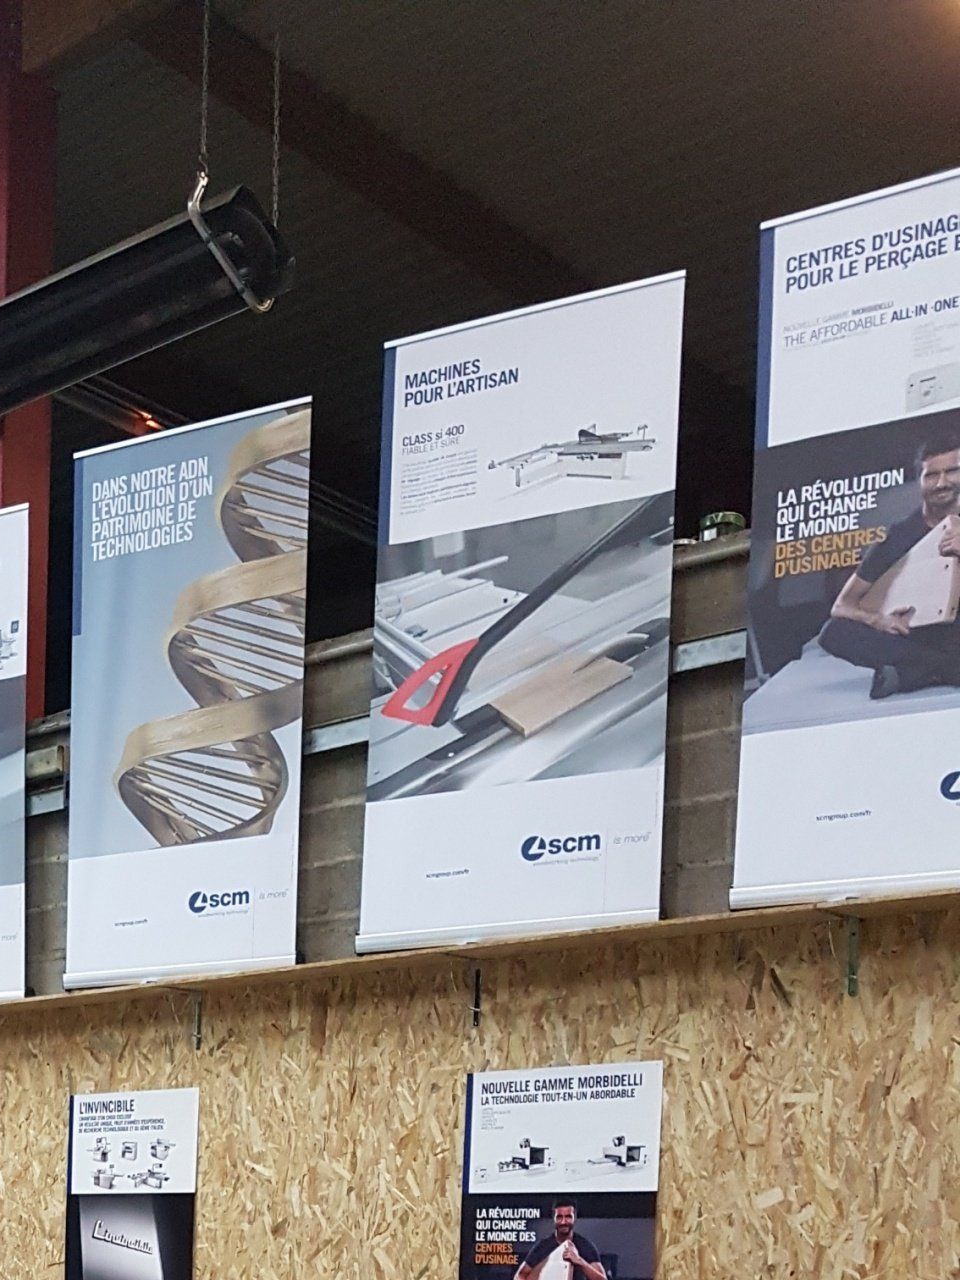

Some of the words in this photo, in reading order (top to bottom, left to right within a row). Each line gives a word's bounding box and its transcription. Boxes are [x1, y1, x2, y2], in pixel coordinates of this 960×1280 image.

[786, 239, 865, 274] CENTRES
[872, 215, 960, 251] D'USINAG
[786, 267, 833, 293] POUR
[840, 260, 858, 279] LE
[865, 237, 947, 273] PERÇAGE
[784, 331, 804, 348] THE
[810, 312, 887, 341] AFFORDABLE
[405, 359, 480, 390] MACHINES
[405, 385, 444, 407] POUR
[447, 368, 519, 398] L'ARTISAN
[403, 432, 432, 447] CLASS
[445, 425, 464, 437] 400
[93, 476, 127, 501] DANS
[131, 464, 176, 492] NOTRE
[179, 456, 208, 481] ADN
[777, 489, 797, 508] LA
[802, 468, 904, 503] RÉVOLUTION
[93, 485, 175, 521] L'ÉVOLUTION
[180, 476, 212, 501] D'UN
[777, 501, 804, 525] QUI
[809, 491, 877, 518] CHANGE
[92, 505, 174, 541] PATRIMOINE
[178, 500, 196, 522] DE
[776, 526, 793, 543] LE
[798, 513, 859, 539] MONDE
[92, 522, 193, 561] TECHNOLOGIES
[776, 541, 806, 560] DES
[811, 526, 886, 552] CENTRES
[775, 548, 862, 579] D'USINAGE
[548, 834, 600, 854] scm
[210, 891, 249, 907] scm
[481, 1080, 530, 1095] NOUVELLE
[534, 1078, 573, 1092] GAMME
[578, 1073, 642, 1089] MORBIDELLI
[481, 1097, 490, 1105] LA
[492, 1094, 539, 1104] TECHNOLOGIE
[542, 1091, 587, 1102] TOUT-EN-UN
[590, 1089, 635, 1099] ABORDABLE
[80, 1099, 134, 1114] L'INVINCIBILE
[476, 1209, 486, 1218] LA
[489, 1206, 540, 1218] RÉVOLUTION
[476, 1220, 490, 1230] QUI
[493, 1220, 527, 1230] CHANGE
[475, 1243, 512, 1253] CENTRES
[476, 1232, 485, 1241] LE
[487, 1231, 517, 1241] MONDE
[520, 1232, 536, 1241] DES
[475, 1254, 519, 1264] D'USINAGE
